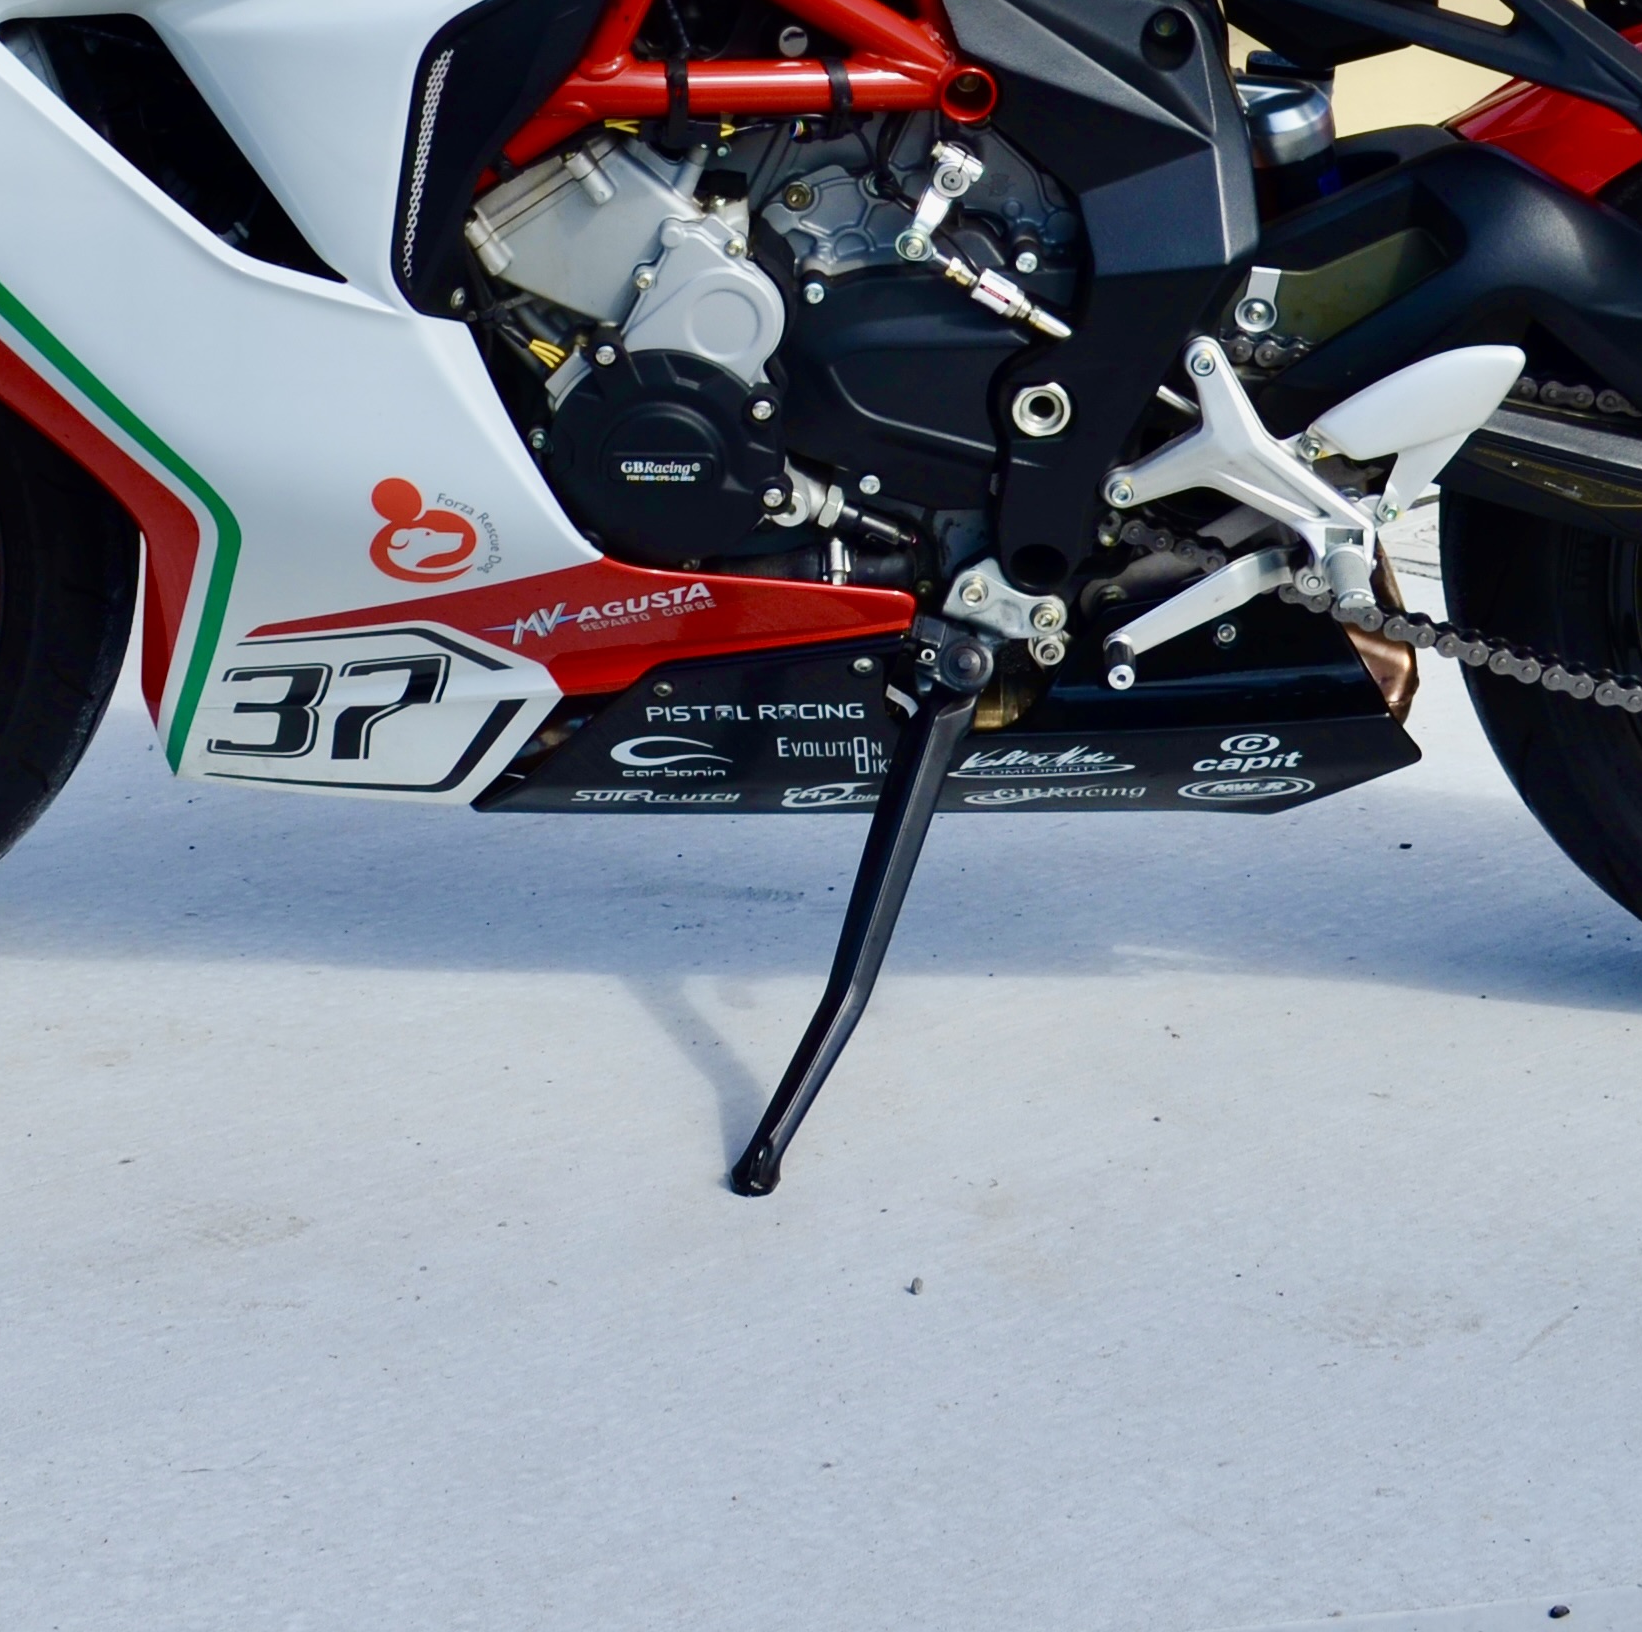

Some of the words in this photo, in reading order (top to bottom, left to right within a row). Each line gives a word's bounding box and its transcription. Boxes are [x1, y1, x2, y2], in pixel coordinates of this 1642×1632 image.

[436, 492, 475, 516] Forza
[477, 511, 500, 552] Rescue
[477, 554, 502, 574] Dog
[512, 602, 567, 646] MV
[576, 582, 711, 623] AGUSTA
[579, 612, 651, 633] REPARTO
[661, 597, 717, 618] CORSE
[207, 653, 451, 760] 37
[622, 767, 726, 777] carbonin
[1193, 751, 1303, 773] capit
